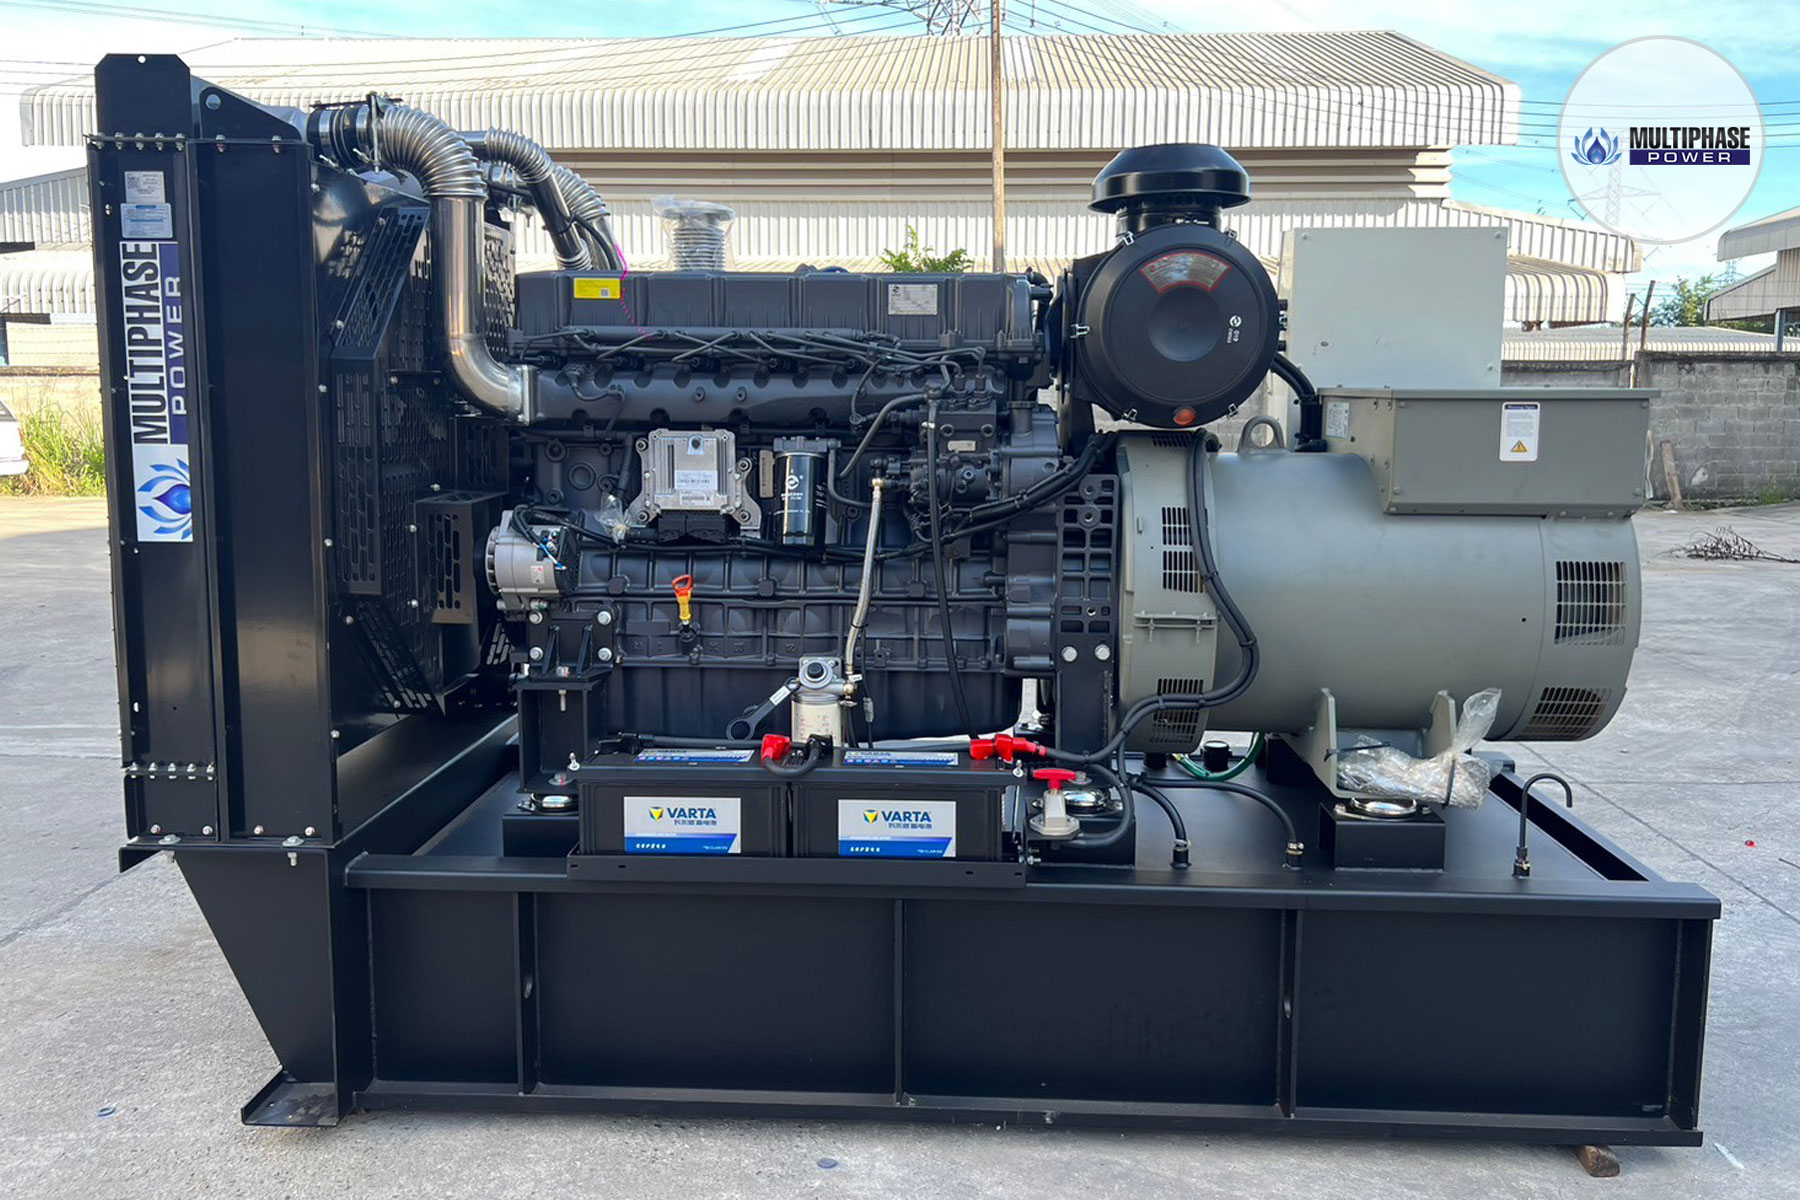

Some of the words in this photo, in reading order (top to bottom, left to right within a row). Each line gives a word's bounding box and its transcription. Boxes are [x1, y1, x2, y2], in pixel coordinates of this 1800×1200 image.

[121, 243, 169, 444] MULTIPHASE
[164, 276, 187, 415] POWER
[667, 807, 717, 819] VARTA
[881, 811, 932, 823] VARTA
